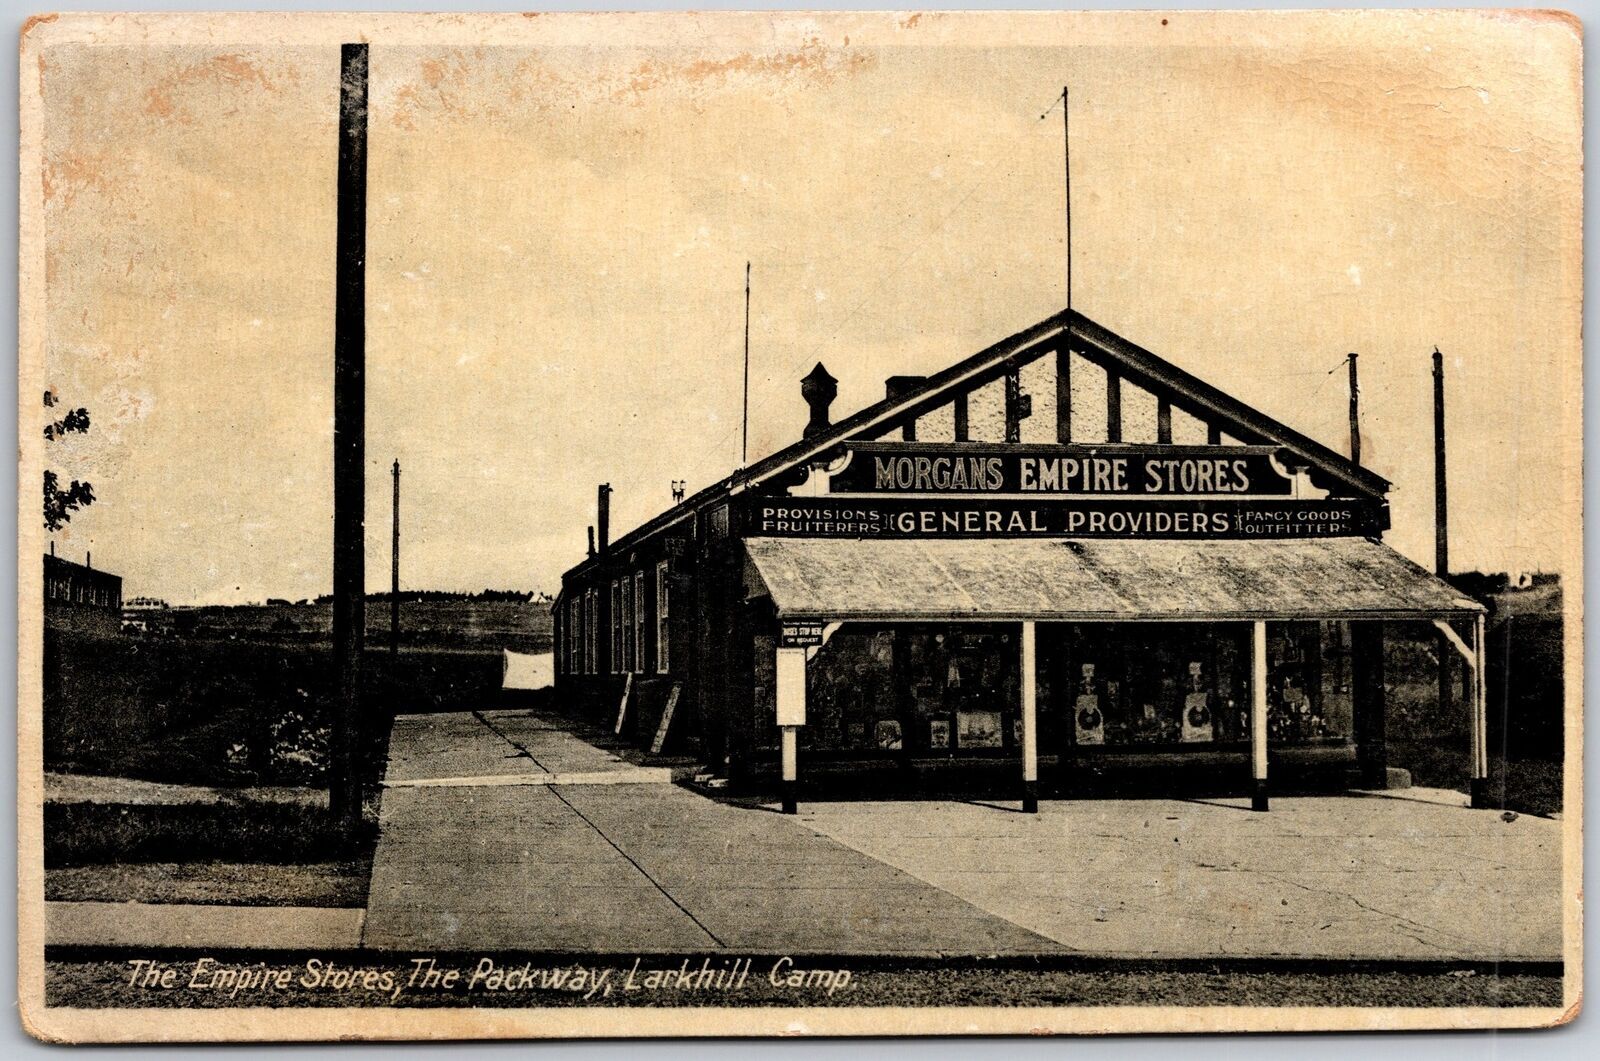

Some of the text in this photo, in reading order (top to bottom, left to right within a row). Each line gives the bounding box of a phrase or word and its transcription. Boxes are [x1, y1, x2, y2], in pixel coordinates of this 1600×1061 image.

[875, 456, 1250, 492] MORGANS EMPIRE STORES
[762, 508, 880, 520] PROVISIONS
[1245, 510, 1352, 521] FANCY GOODS
[762, 521, 881, 533] FRUITERERS
[897, 510, 1230, 533] GENERAL PROVIDERS
[1245, 523, 1352, 534] OUTFITTERS
